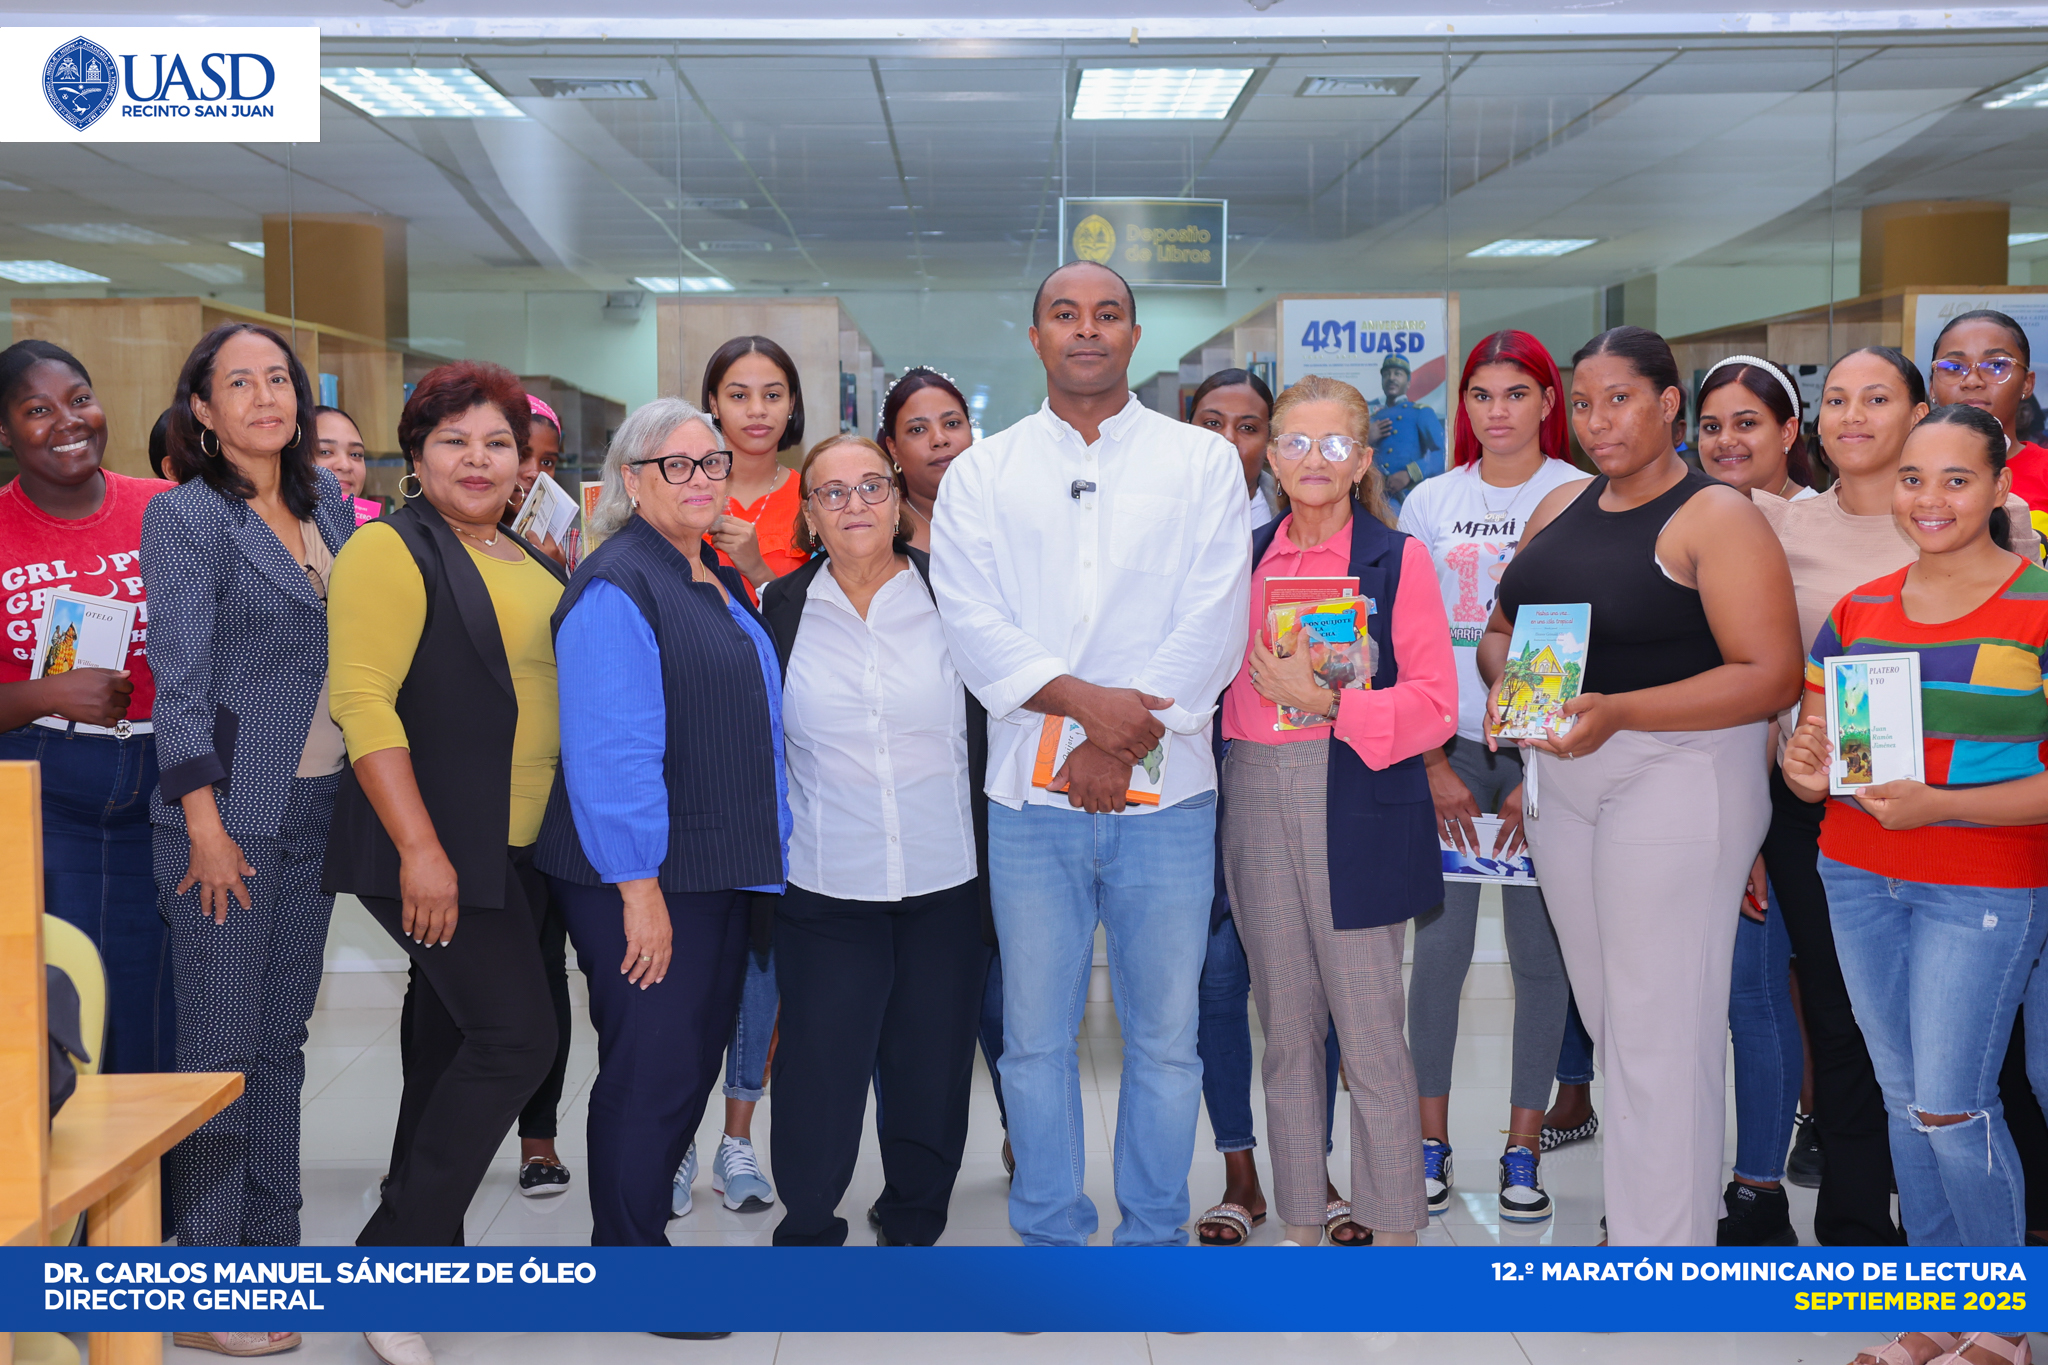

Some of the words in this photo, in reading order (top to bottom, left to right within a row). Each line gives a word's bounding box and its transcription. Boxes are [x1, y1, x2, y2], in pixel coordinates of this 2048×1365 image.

[1125, 244, 1153, 262] de
[1157, 245, 1211, 264] Libros
[1361, 320, 1427, 330] ANIVERSARIO
[1360, 332, 1426, 353] UASD
[1, 559, 78, 591] GRL
[1444, 542, 1487, 622] 1
[85, 610, 114, 622] OTELO
[1320, 618, 1352, 627] QUIJOTE
[77, 658, 100, 668] William
[1869, 666, 1900, 675] PLATERO
